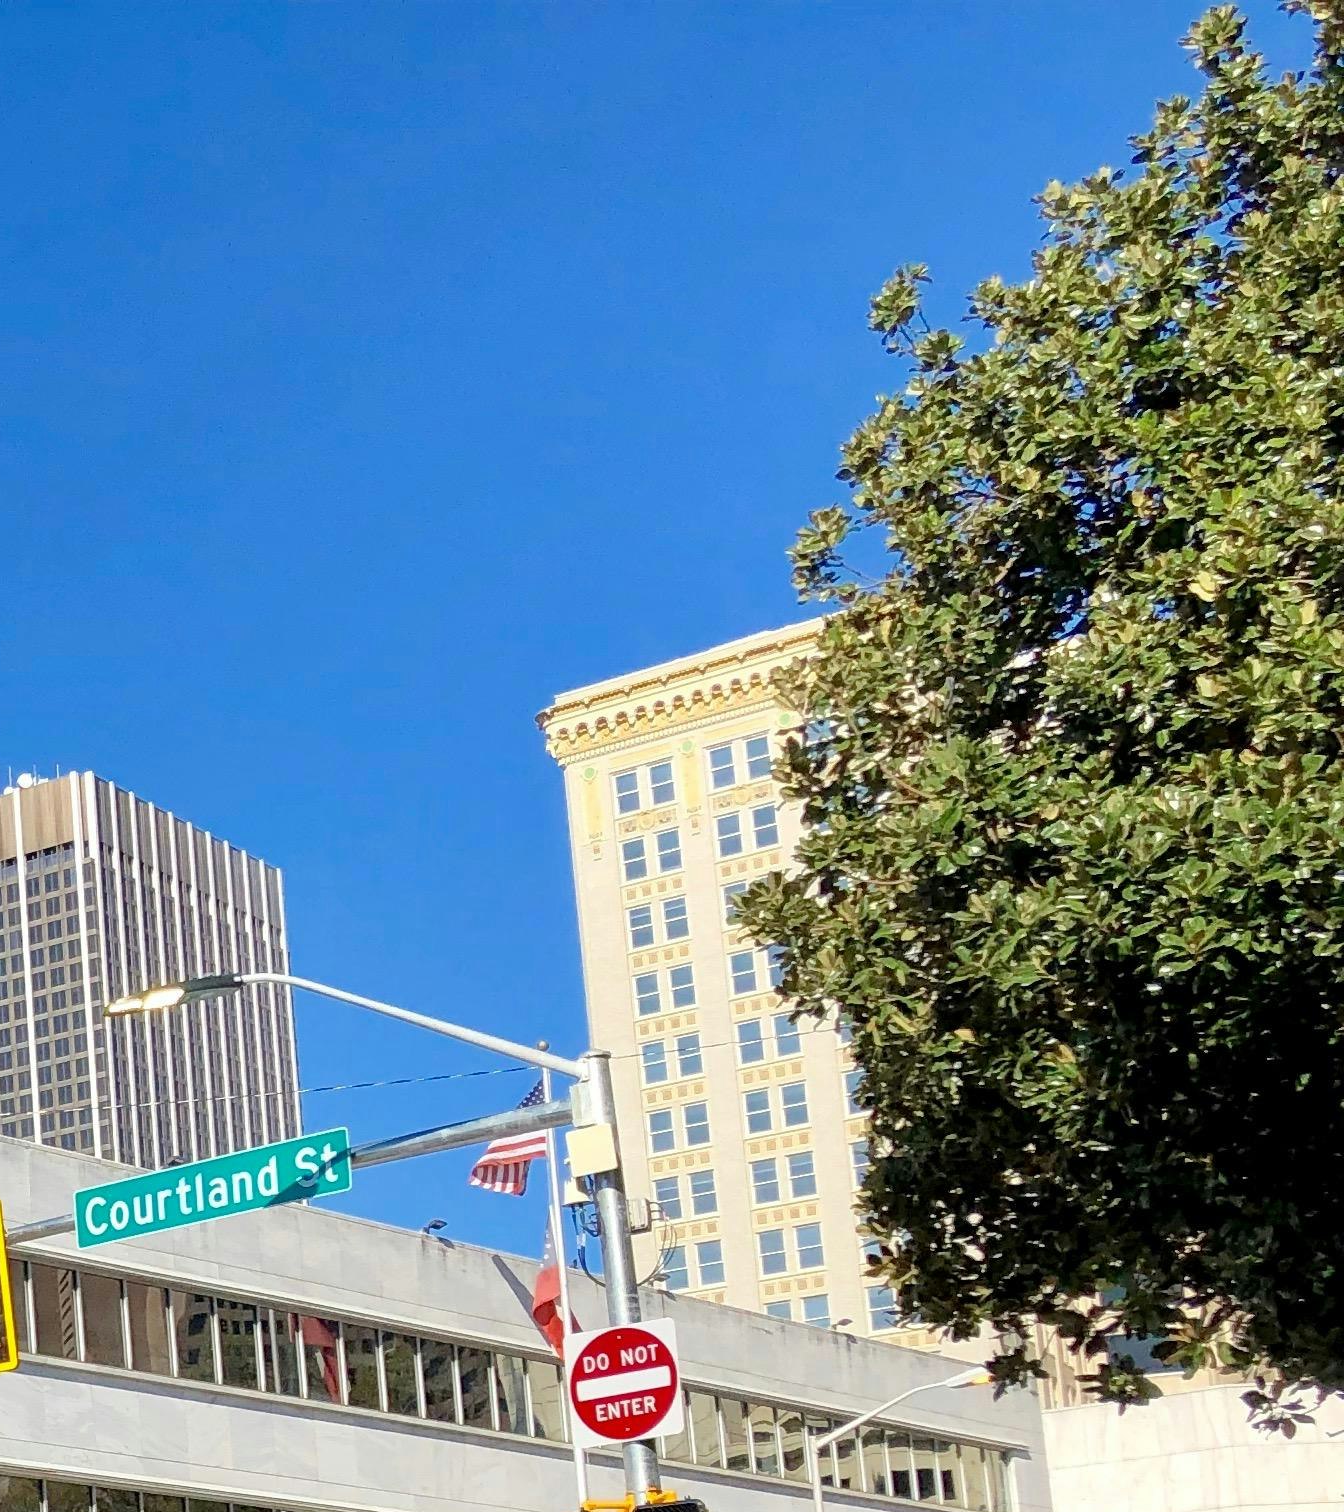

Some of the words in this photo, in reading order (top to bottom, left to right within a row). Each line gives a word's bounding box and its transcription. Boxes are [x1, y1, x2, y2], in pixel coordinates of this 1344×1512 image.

[85, 1155, 280, 1236] Courtland
[294, 1143, 339, 1188] St
[582, 1353, 610, 1374] DO
[620, 1344, 659, 1367] NOT
[595, 1395, 658, 1422] ENTER
